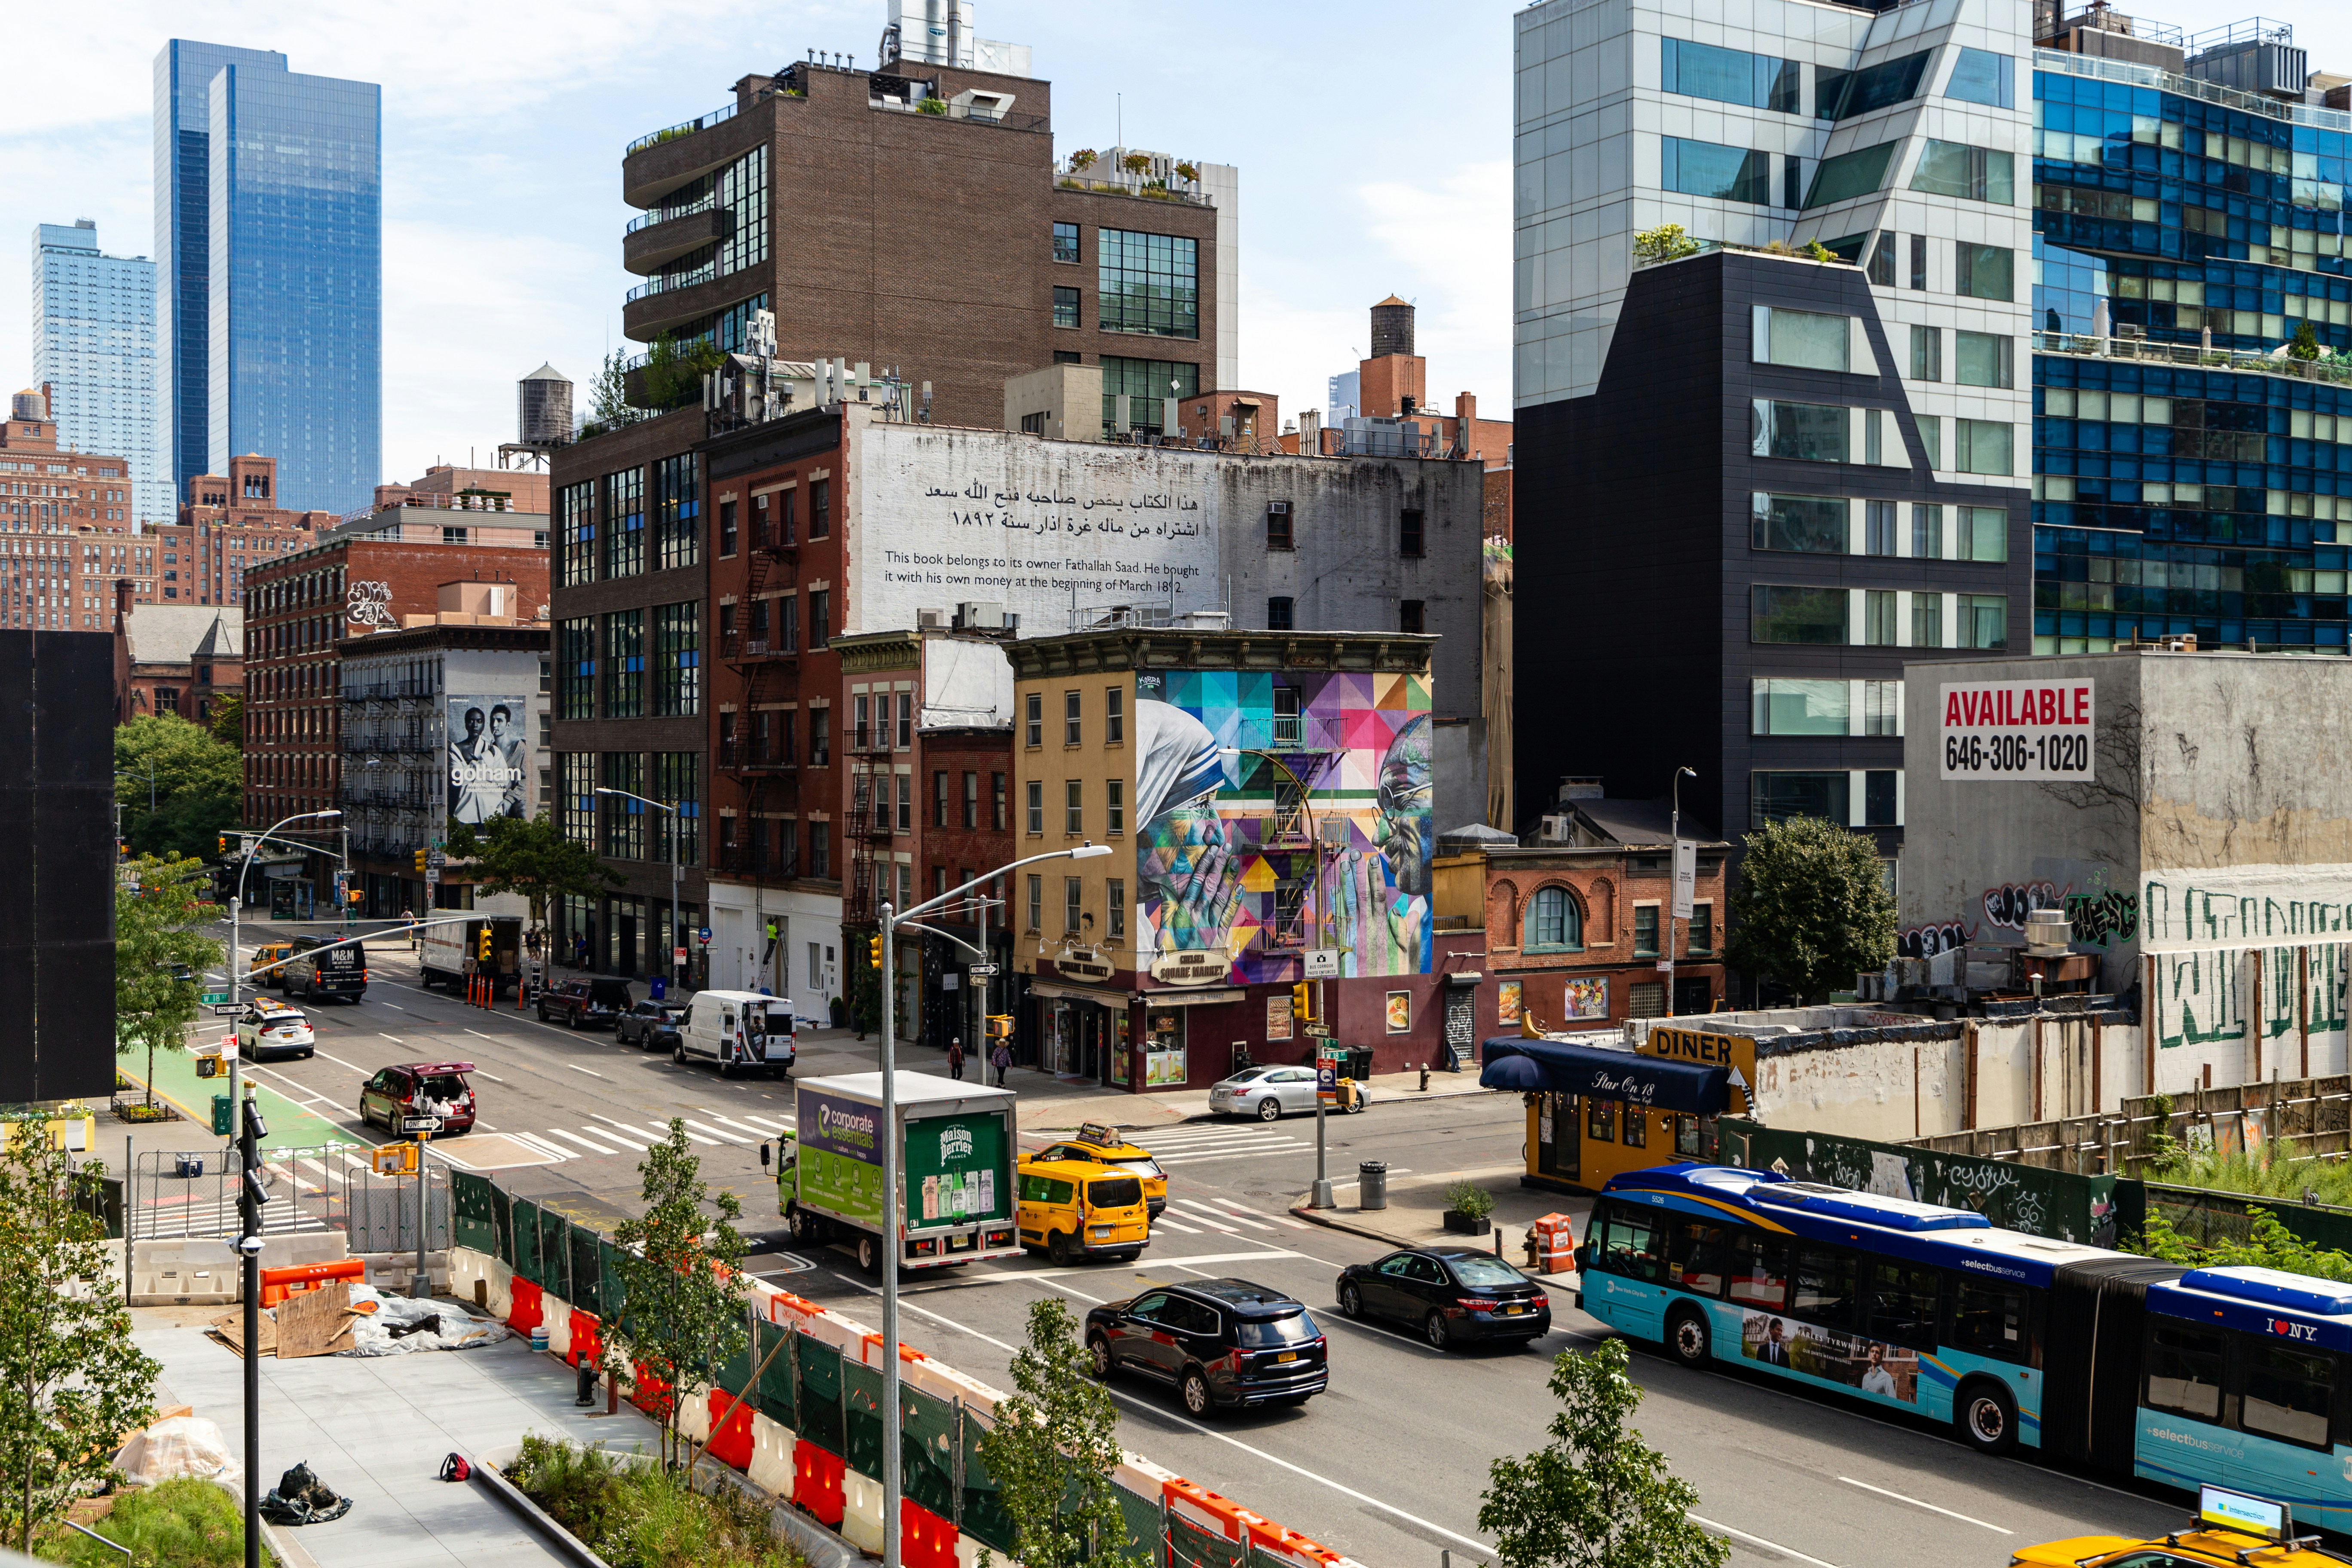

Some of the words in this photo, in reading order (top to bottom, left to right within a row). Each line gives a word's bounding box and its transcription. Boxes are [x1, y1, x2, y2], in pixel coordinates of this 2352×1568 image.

[925, 486, 958, 497] سعد
[995, 487, 1019, 508] فتح
[1026, 489, 1076, 507] صاحبه
[1083, 493, 1124, 512] يخص
[1130, 493, 1171, 514] الكتاب
[1177, 495, 1197, 510] هذا
[953, 511, 994, 527] ١٨٩٢
[1001, 511, 1029, 529] سنة
[1034, 515, 1060, 535] اذار
[1067, 517, 1092, 536] غرة
[1130, 523, 1150, 537] من
[1156, 521, 1198, 540] اشتراه
[885, 551, 909, 564] This
[914, 553, 943, 565] book
[947, 554, 989, 570] belongs
[994, 558, 1006, 567] to
[1010, 557, 1022, 568] its
[1026, 560, 1062, 570] owner
[1066, 559, 1112, 572] Fathallah
[1115, 561, 1142, 573] Saad.
[1145, 563, 1160, 574] He
[1164, 564, 1199, 579] bought
[885, 570, 893, 581] it
[897, 571, 922, 583] with
[927, 572, 941, 583] his
[946, 576, 970, 584] own
[974, 576, 1011, 589] money
[1016, 577, 1026, 586] at
[1030, 576, 1047, 588] the
[1052, 577, 1102, 592] beginning
[1105, 579, 1118, 590] of
[1120, 580, 1152, 591] March
[1139, 676, 1160, 684] KOBRA
[1945, 687, 2089, 727] AVAILABLE
[1946, 733, 2088, 772] 646-306-1020
[451, 763, 521, 786] gotham
[332, 950, 354, 961] M&M
[1073, 951, 1093, 962] CHELSEA
[1180, 954, 1205, 964] CHELSEA
[1059, 961, 1081, 973] SQUARE
[1082, 964, 1108, 977] MARKET
[1161, 966, 1191, 980] SQUARE
[1192, 965, 1224, 978] MARKET
[1586, 1006, 1606, 1015] GROCERIES
[1325, 1038, 1330, 1047] 10
[1657, 1031, 1731, 1064] DINER
[1592, 1072, 1619, 1090] Star
[1622, 1076, 1638, 1093] On
[1642, 1084, 1655, 1096] 18
[1627, 1093, 1640, 1102] Diner
[832, 1110, 873, 1133] corporate
[832, 1126, 874, 1149] essentials
[940, 1127, 972, 1145] Maison
[839, 1145, 849, 1154] culture.
[857, 1150, 867, 1160] happy.
[940, 1139, 973, 1167] perrier
[1652, 1195, 1664, 1204] 5526
[2266, 1318, 2275, 1332] I
[1791, 1328, 1823, 1342] CHARLES
[1826, 1336, 1867, 1353] TYRWHITT
[1835, 1355, 1852, 1365] BUSINESS
[2228, 1502, 2266, 1522] Intersection
